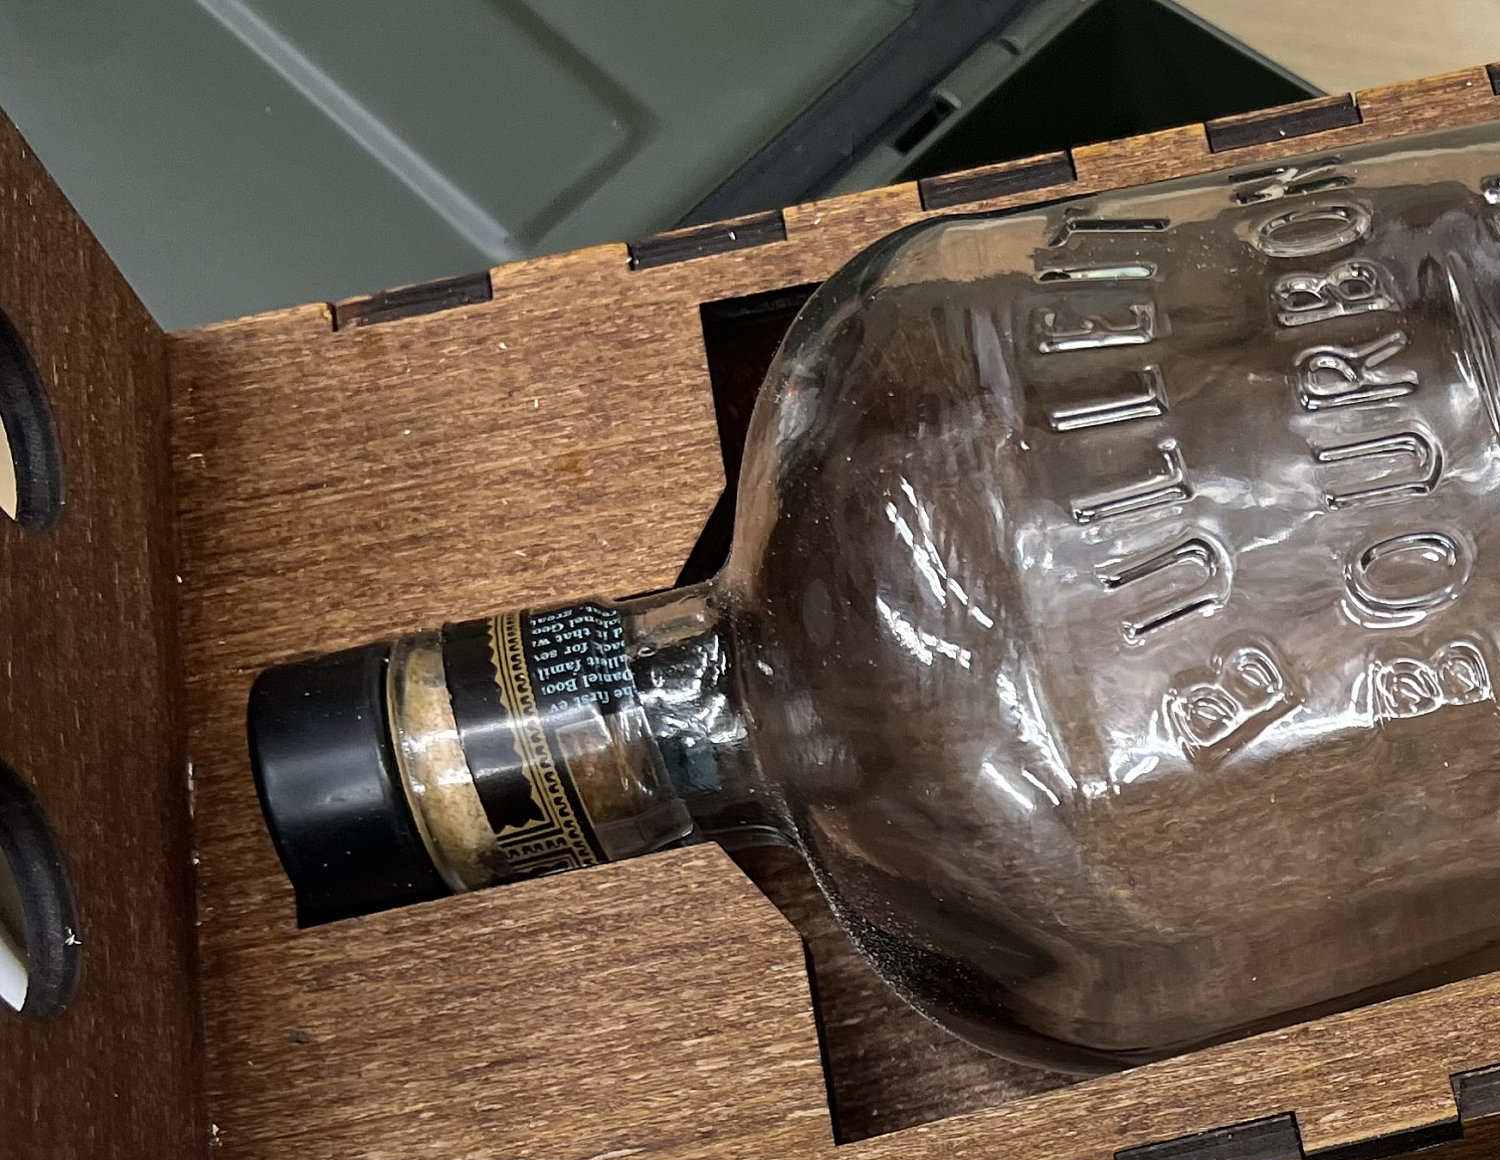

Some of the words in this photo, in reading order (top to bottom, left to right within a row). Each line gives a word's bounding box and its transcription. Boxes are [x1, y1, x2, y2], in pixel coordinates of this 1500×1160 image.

[1034, 205, 1303, 757] BULLEIT
[1228, 155, 1493, 728] BOURBON
[564, 642, 589, 655] for
[582, 669, 634, 688] Daniel
